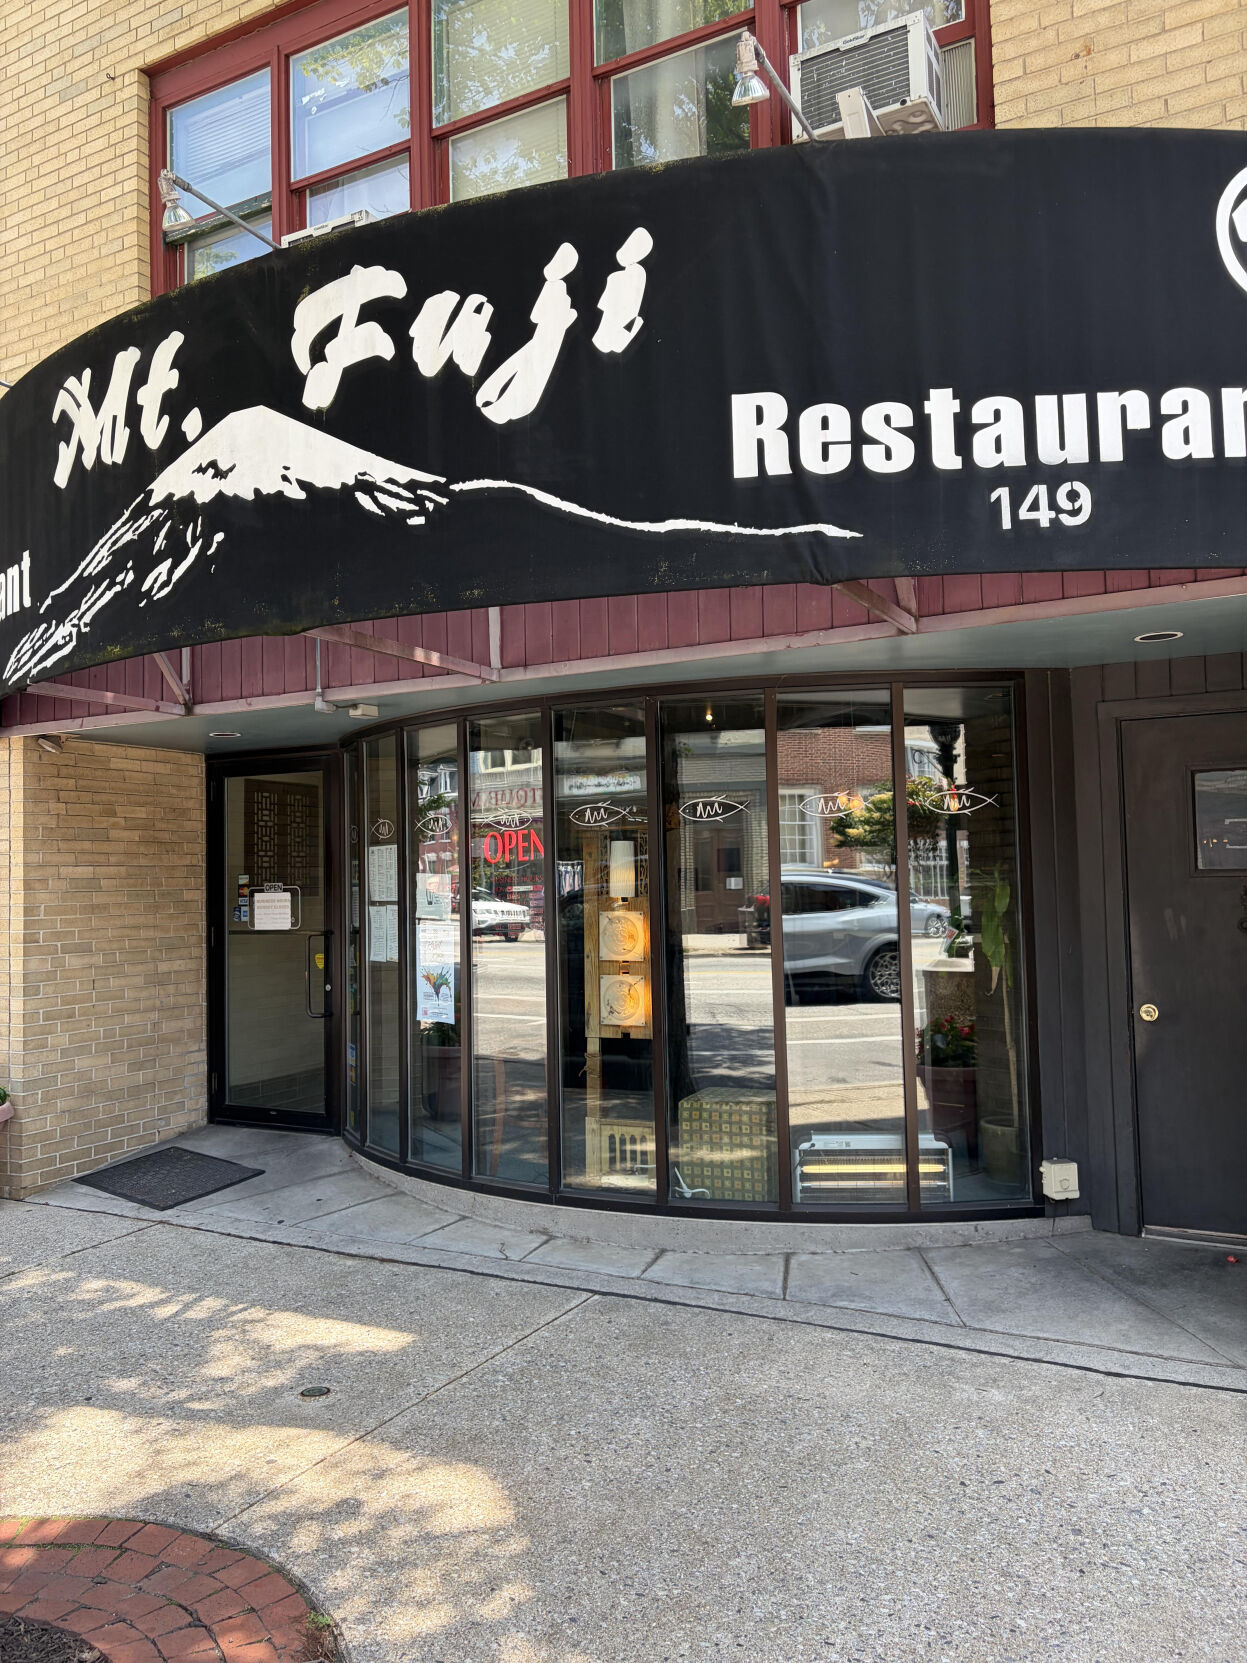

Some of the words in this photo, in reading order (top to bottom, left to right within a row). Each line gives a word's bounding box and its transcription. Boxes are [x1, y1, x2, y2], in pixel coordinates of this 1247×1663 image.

[52, 330, 202, 489] Mt.
[291, 227, 653, 425] Fuji
[990, 481, 1092, 530] 149
[483, 829, 545, 864] OPEN
